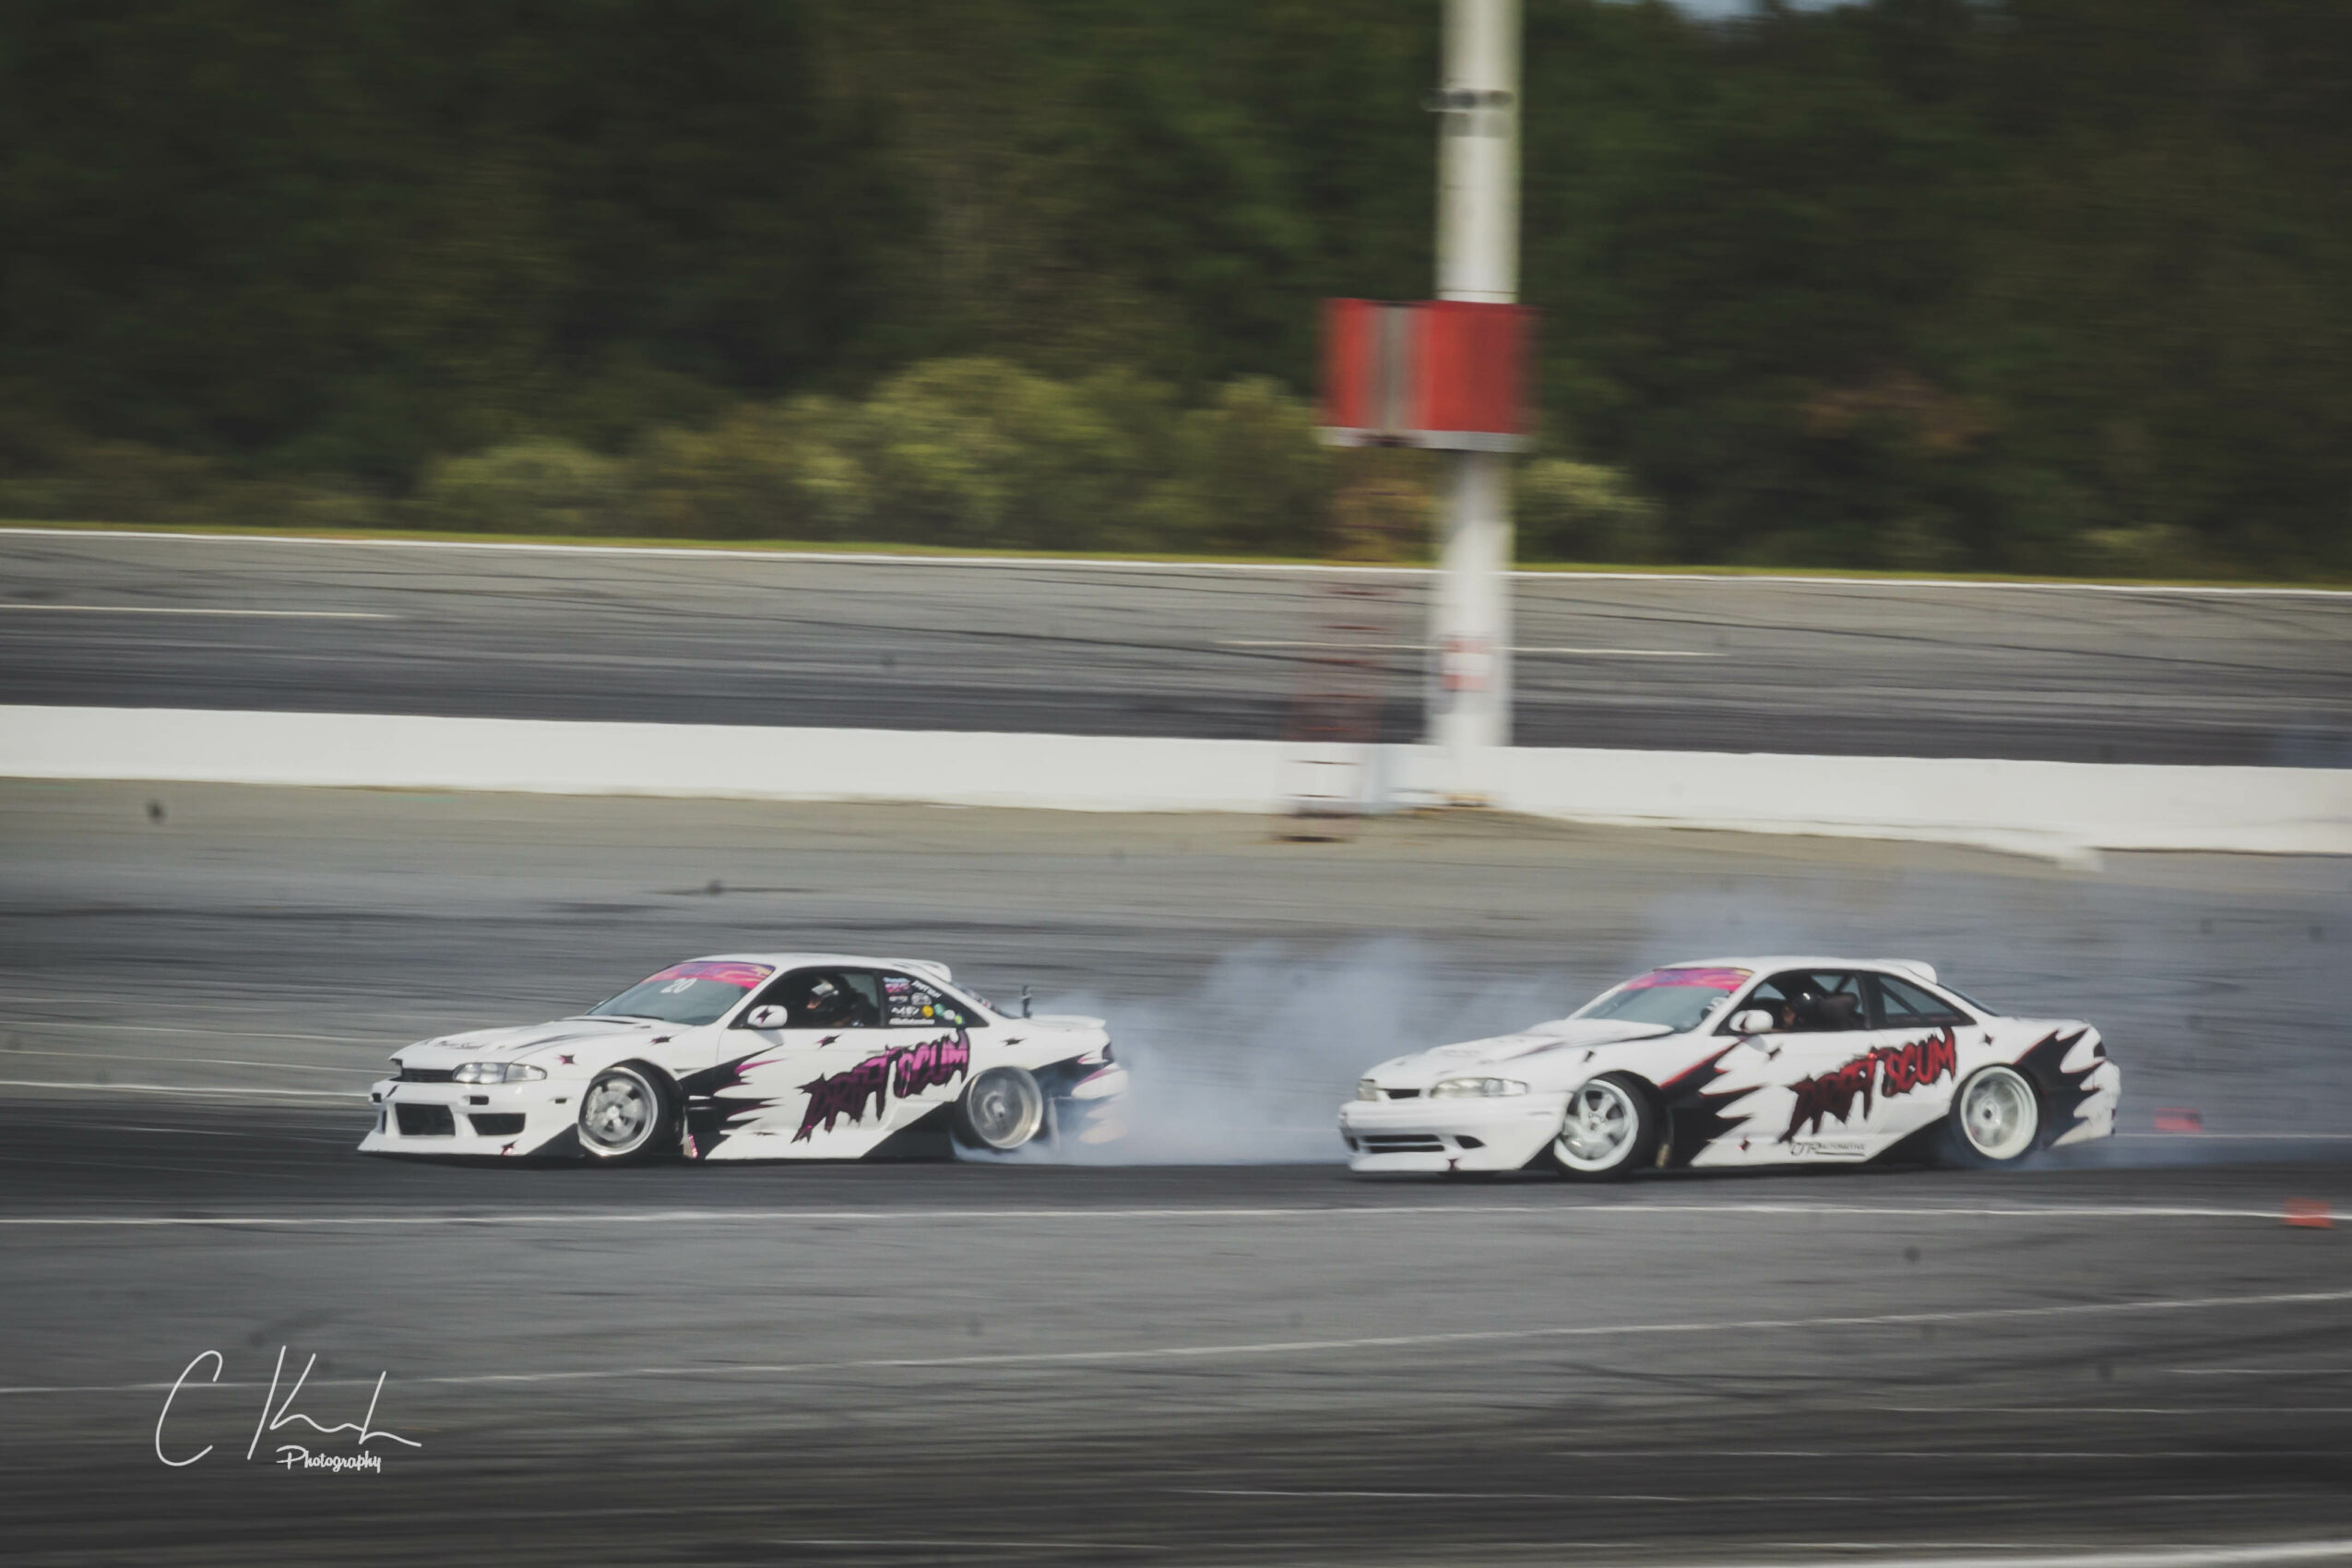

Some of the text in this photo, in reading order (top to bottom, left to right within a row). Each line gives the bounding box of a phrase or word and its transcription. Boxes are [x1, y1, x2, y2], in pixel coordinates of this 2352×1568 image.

[660, 978, 697, 994] 20
[791, 1029, 970, 1144] DRIFT SCUM
[1883, 1027, 1956, 1098] SCUM
